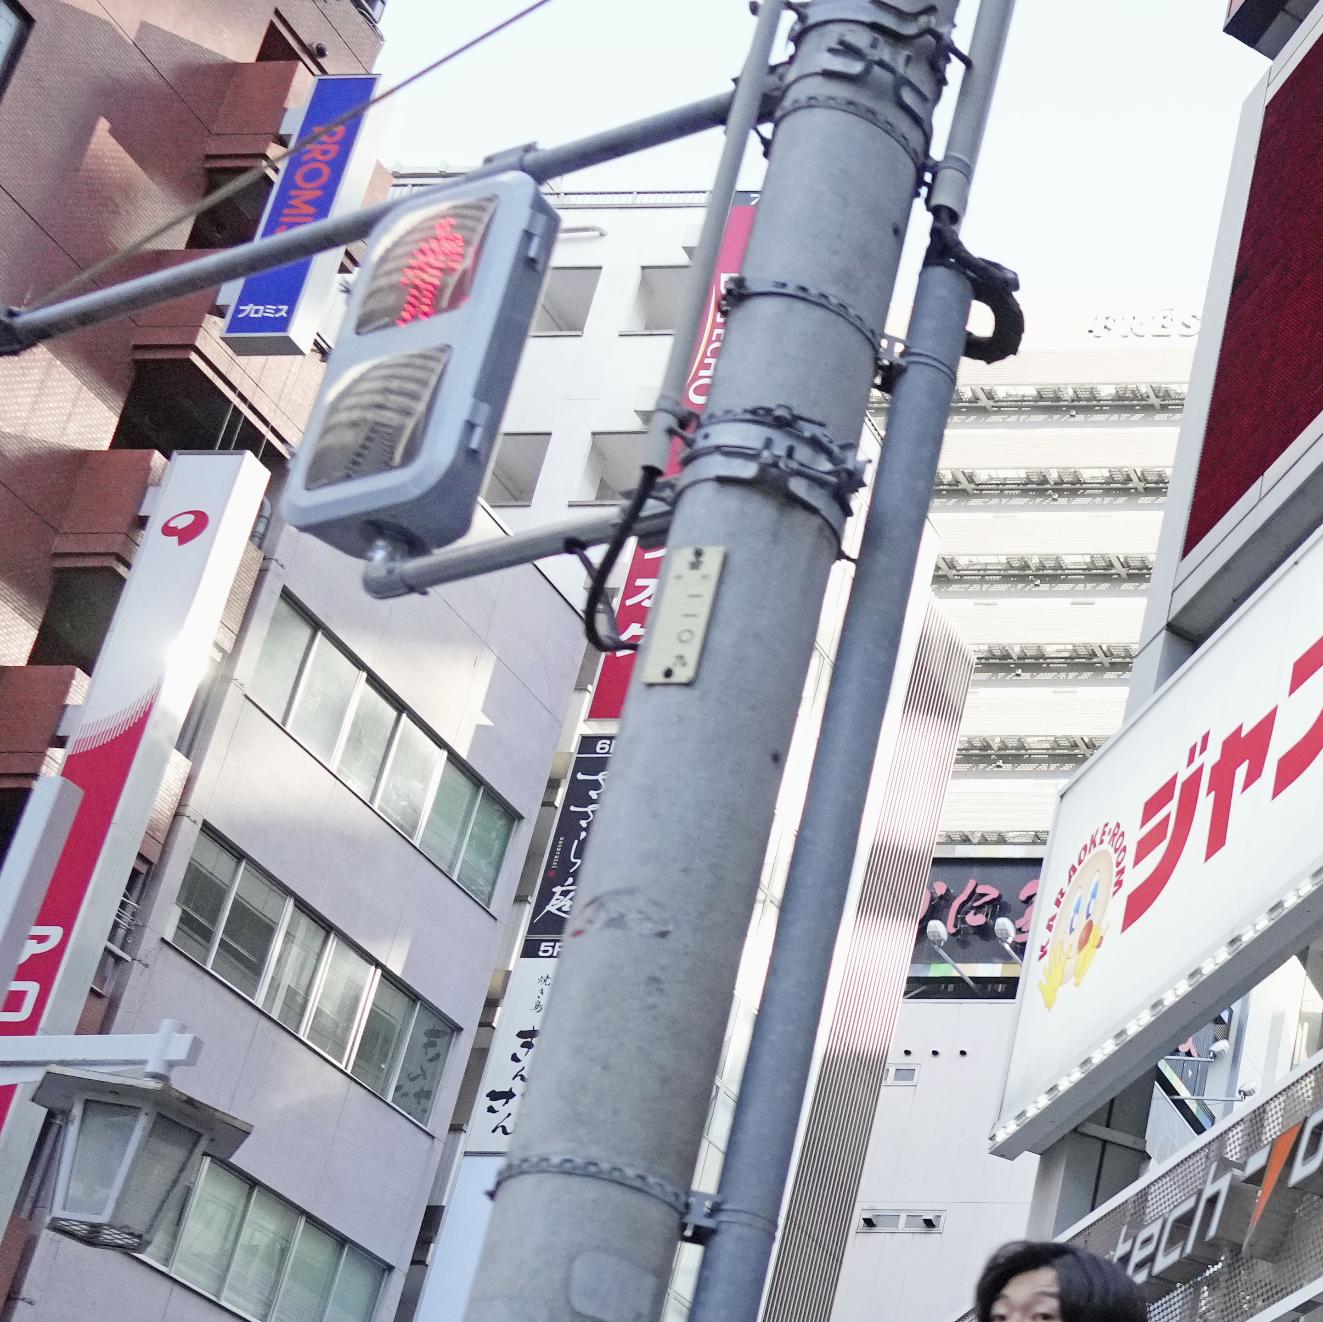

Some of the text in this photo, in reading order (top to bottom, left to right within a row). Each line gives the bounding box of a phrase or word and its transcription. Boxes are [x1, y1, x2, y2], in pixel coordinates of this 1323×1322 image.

[276, 124, 346, 236] PROMI
[238, 303, 289, 319] プロミス
[1110, 1158, 1228, 1285] tech
